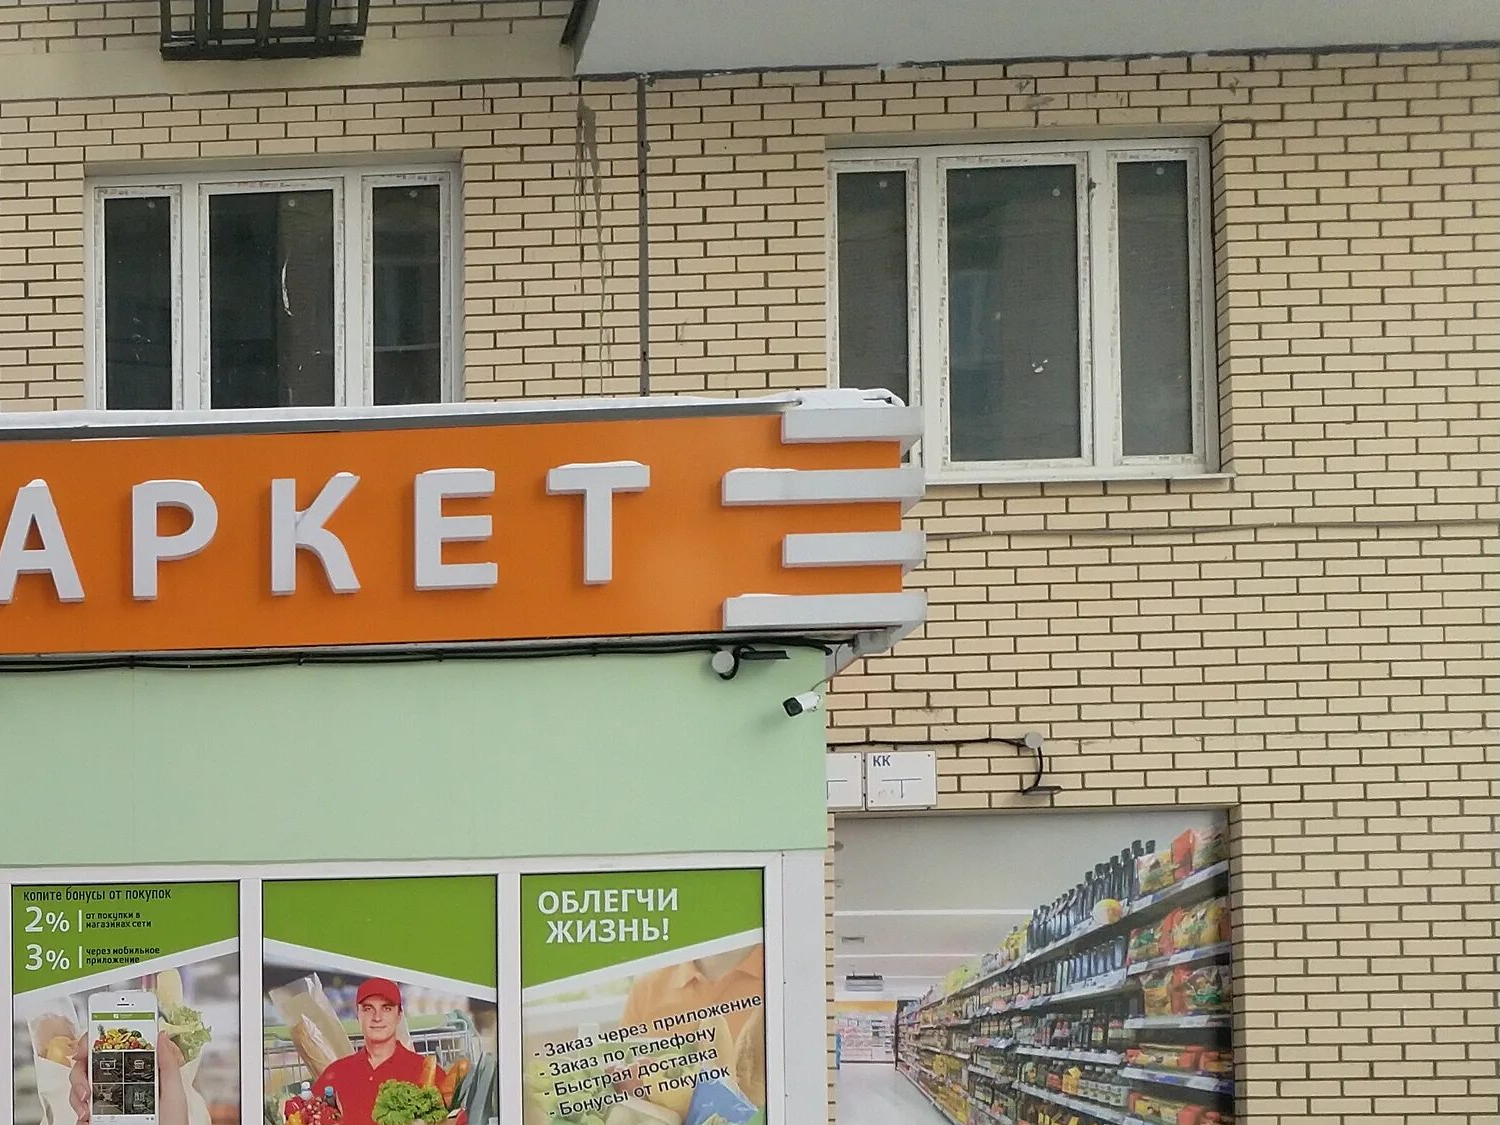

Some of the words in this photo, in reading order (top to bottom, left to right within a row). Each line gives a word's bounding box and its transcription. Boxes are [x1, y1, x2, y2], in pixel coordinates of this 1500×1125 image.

[872, 755, 891, 767] КК
[23, 890, 62, 900] копите
[65, 886, 105, 903] бонусы
[109, 890, 122, 900] от
[125, 889, 171, 902] покупок
[538, 888, 678, 915] ОБЛЕГЧИ
[24, 906, 70, 932] 2%
[85, 912, 96, 920] от
[97, 912, 134, 921] покупки
[131, 920, 151, 928] сети
[545, 918, 669, 944] ЖИЗНЬ!
[24, 944, 70, 970] 3%
[85, 947, 111, 957] через
[112, 946, 160, 955] мобильное
[86, 956, 140, 966] приложение
[543, 1035, 594, 1058] Заказ
[597, 1021, 649, 1045] через
[652, 993, 763, 1032] приложение
[548, 1054, 599, 1077] Заказ
[603, 1049, 626, 1065] по
[631, 1025, 717, 1058] телефону
[554, 1067, 633, 1097] Быстрая
[637, 1046, 719, 1078] доставка
[559, 1091, 629, 1117] Бонусы
[633, 1083, 653, 1098] от
[658, 1064, 731, 1094] покупок
